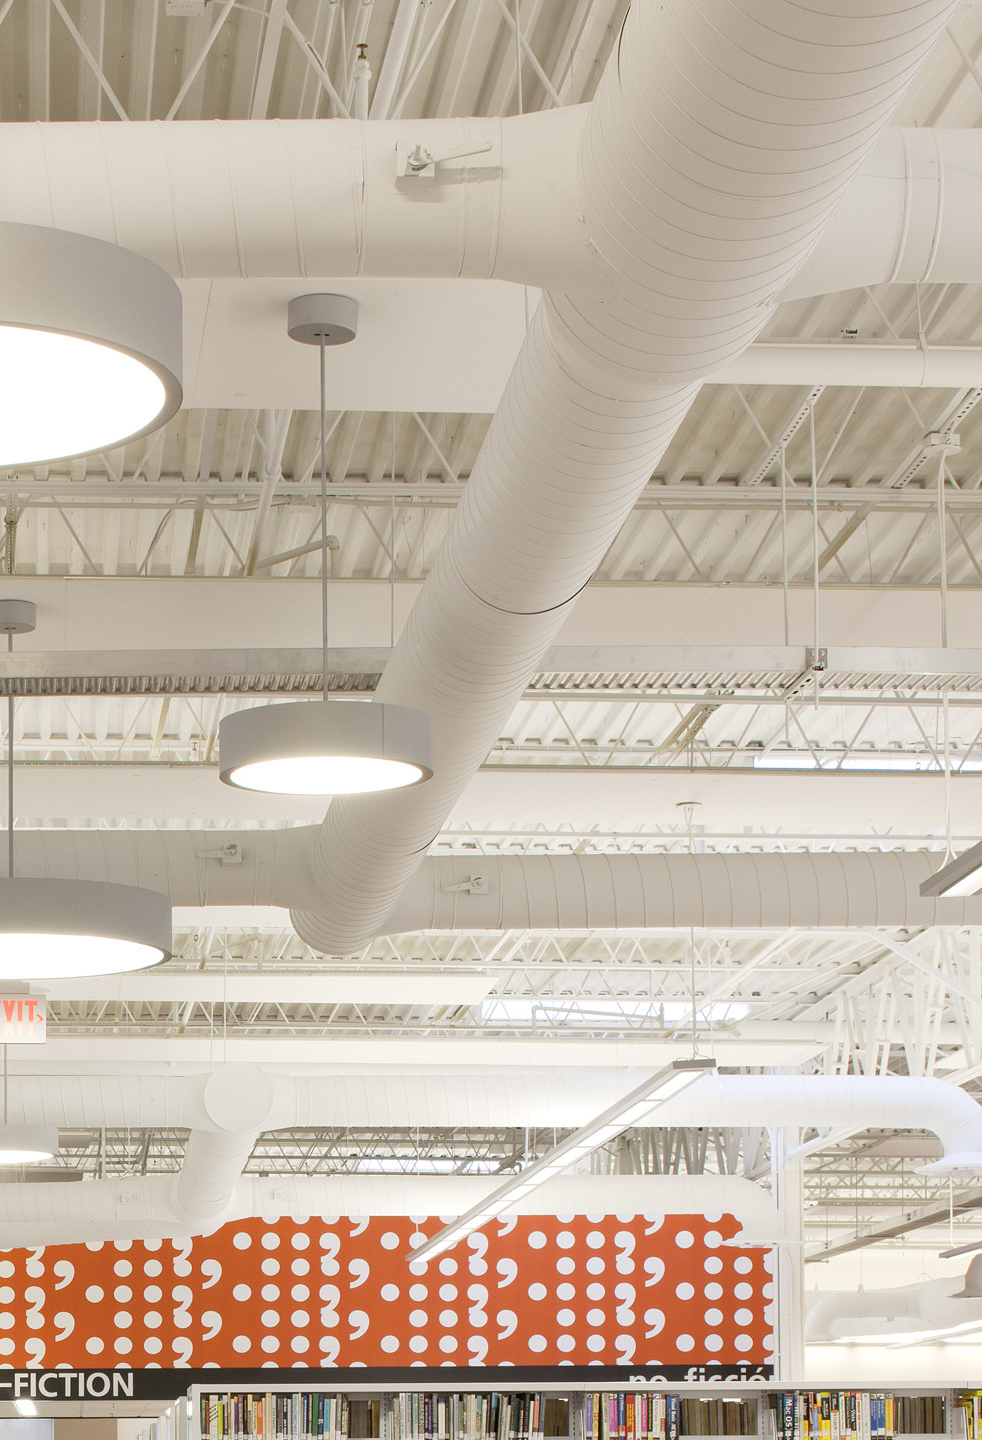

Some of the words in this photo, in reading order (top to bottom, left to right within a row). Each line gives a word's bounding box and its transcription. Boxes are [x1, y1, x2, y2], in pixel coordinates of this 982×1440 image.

[684, 1367, 775, 1382] fiió
[785, 1399, 793, 1414] Mac
[785, 1416, 793, 1427] OS
